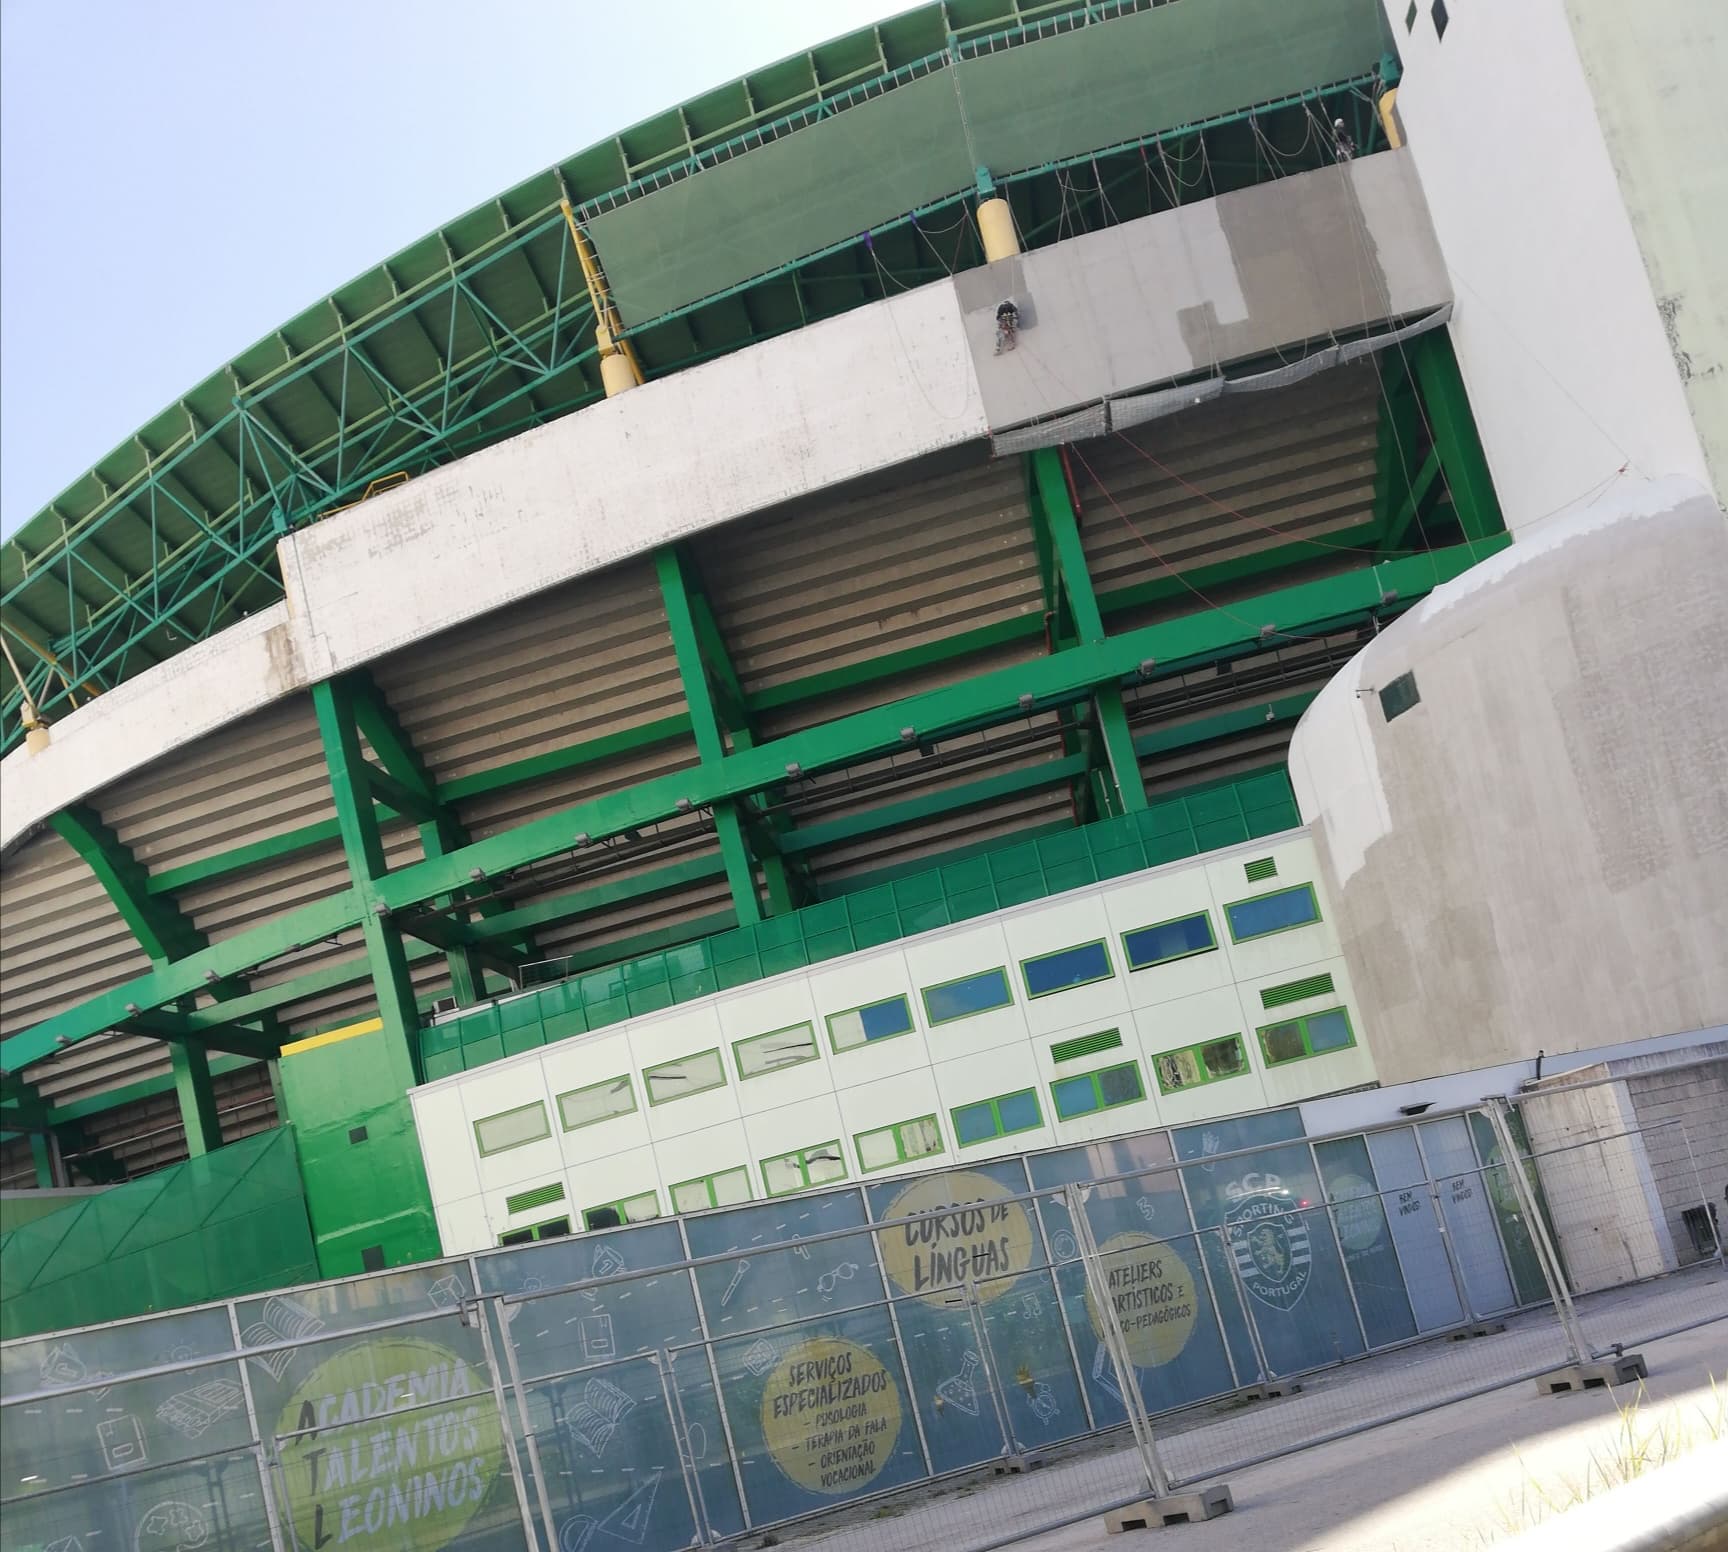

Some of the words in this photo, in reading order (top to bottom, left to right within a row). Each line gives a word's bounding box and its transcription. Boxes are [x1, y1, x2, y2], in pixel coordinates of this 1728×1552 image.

[904, 1198, 986, 1247] CURSOS
[990, 1202, 1009, 1223] DE
[1233, 1202, 1295, 1237] SPORTING
[914, 1237, 1010, 1292] LÍNGUAS
[1108, 1259, 1163, 1289] ATELIERS
[1111, 1282, 1174, 1314] ARTÍSTICOS
[1177, 1285, 1185, 1298] E
[1252, 1270, 1308, 1297] PORTUGAL
[789, 1351, 853, 1387] SERVIÇOS
[295, 1358, 470, 1447] ACADEMIA
[773, 1368, 888, 1419] ESPECIALIZADOS
[302, 1405, 480, 1496] TALENTOS
[805, 1429, 844, 1452] TERAPIA
[848, 1425, 861, 1441] DA
[864, 1416, 887, 1436] FALA
[820, 1438, 876, 1469] ORIENTAÇÃO
[820, 1459, 877, 1488] VOCACIONAL
[314, 1456, 486, 1550] LEONINOS
